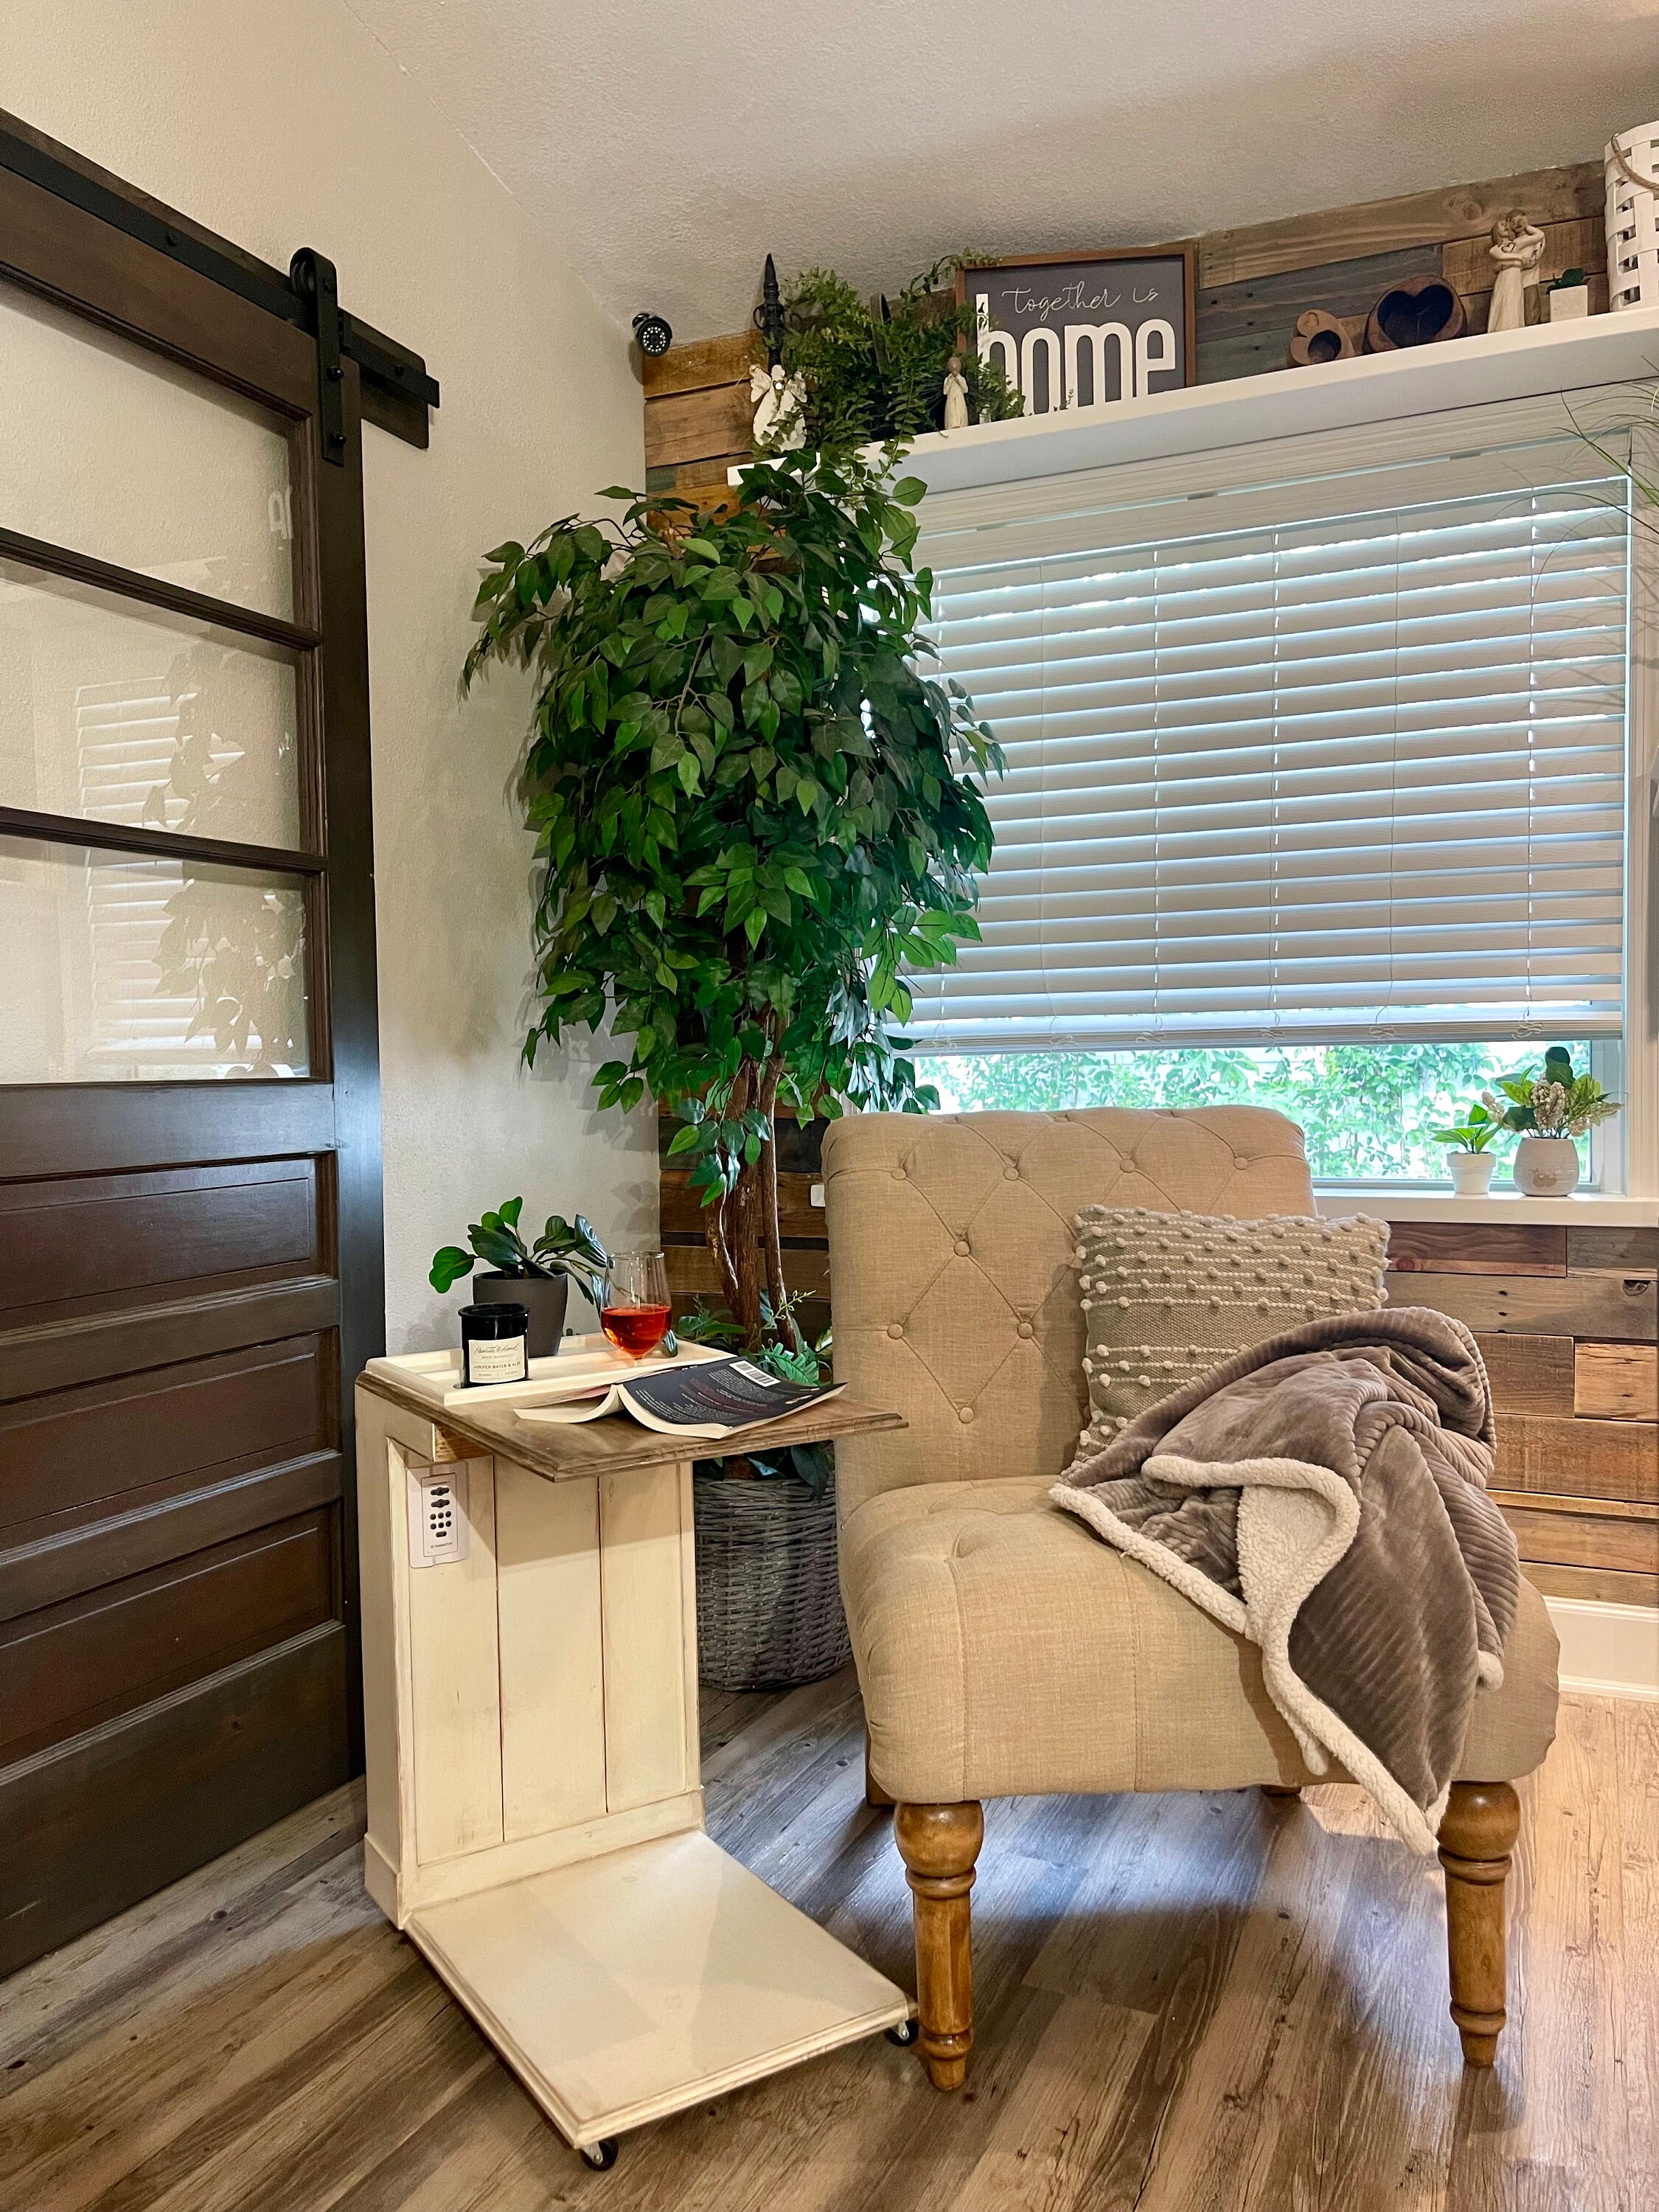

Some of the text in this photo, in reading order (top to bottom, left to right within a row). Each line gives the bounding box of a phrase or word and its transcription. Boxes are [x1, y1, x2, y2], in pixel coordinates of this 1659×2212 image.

[1001, 280, 1159, 321] together is
[975, 293, 1177, 424] home
